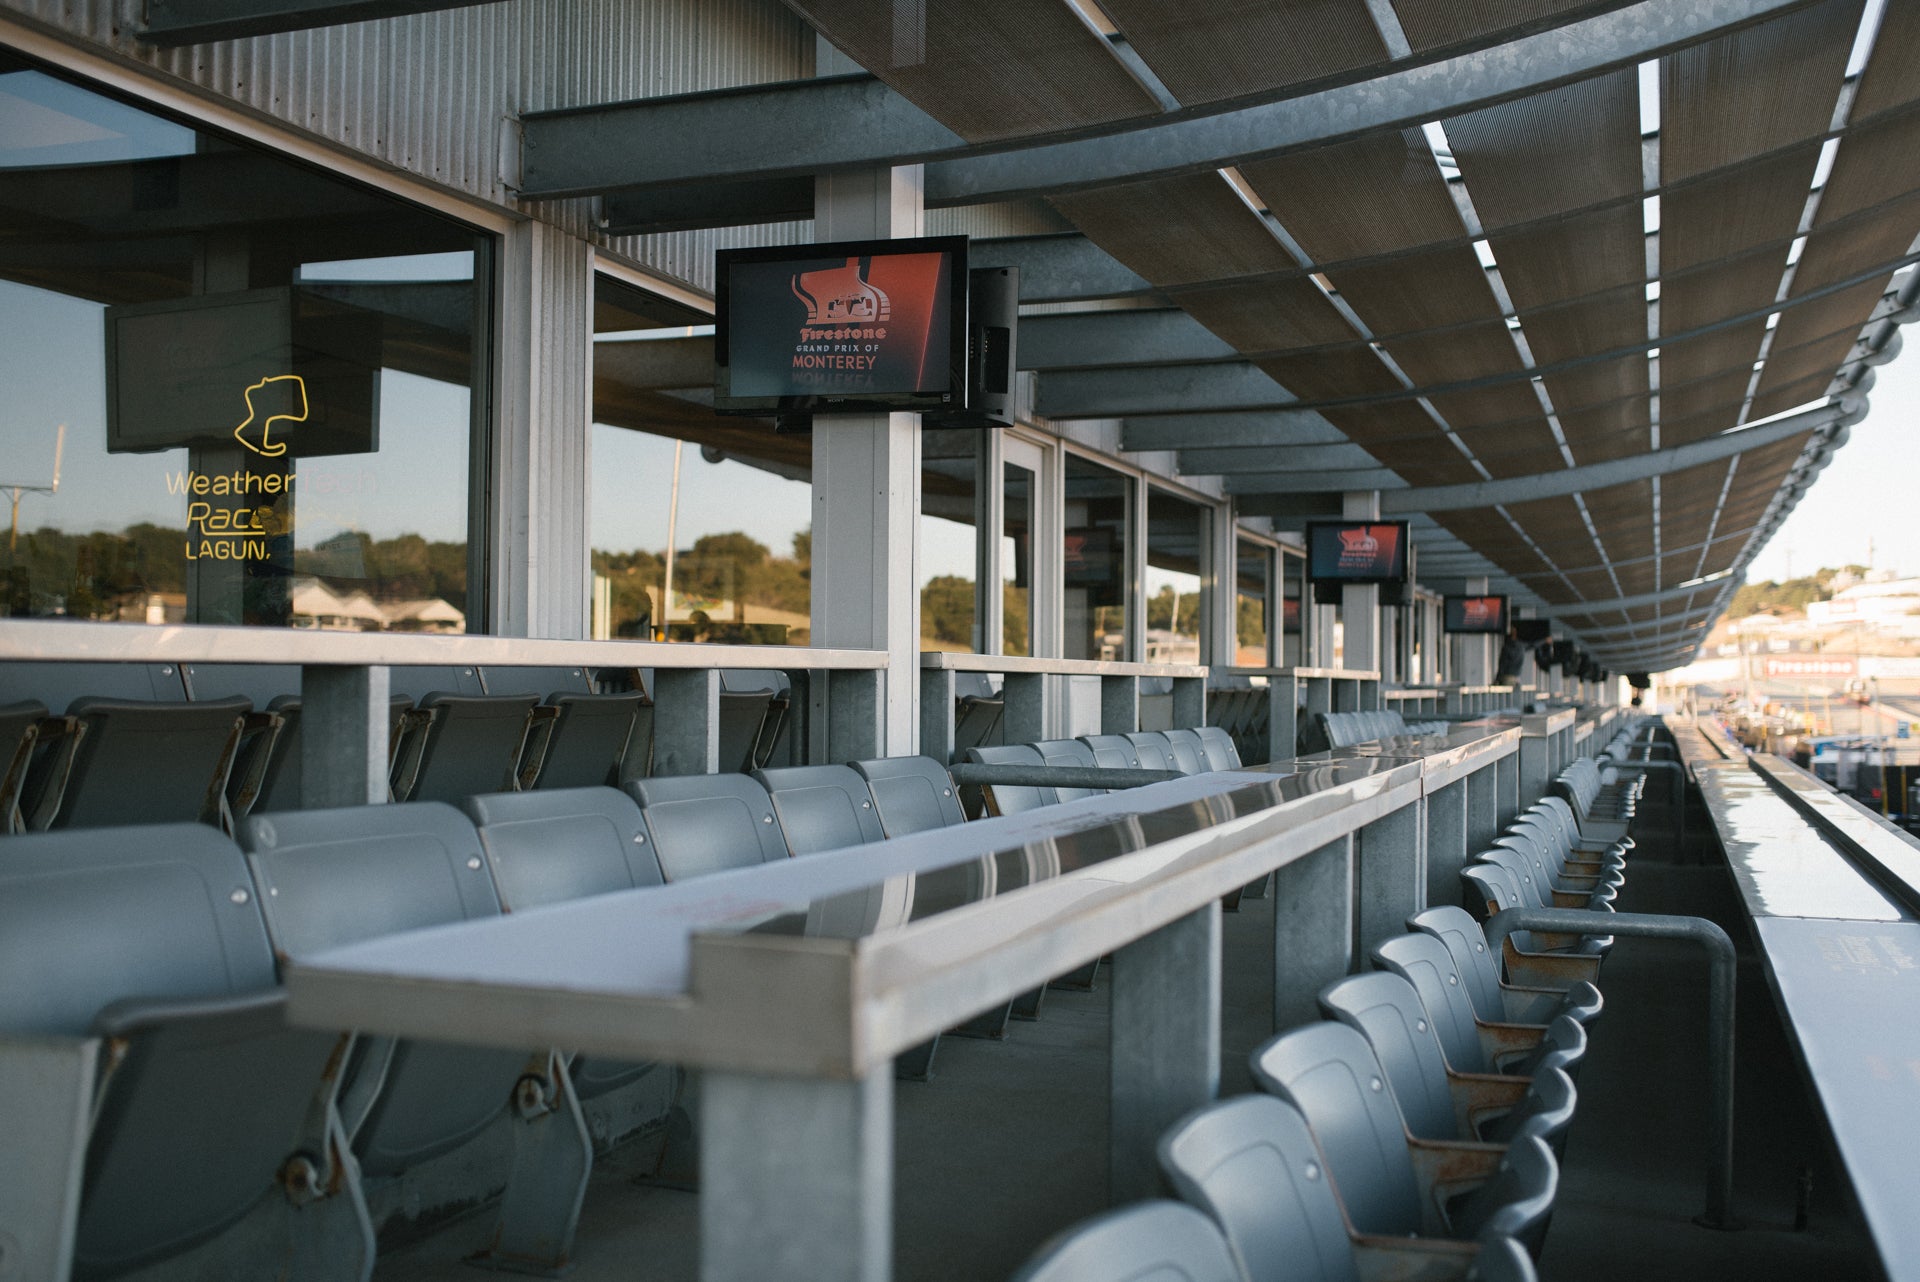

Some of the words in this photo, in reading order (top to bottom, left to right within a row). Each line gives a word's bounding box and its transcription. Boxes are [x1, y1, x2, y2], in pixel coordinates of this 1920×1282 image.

[800, 328, 887, 343] Firestone
[796, 344, 830, 352] GRAND
[834, 344, 860, 352] PRIX
[864, 344, 880, 352] OF
[792, 355, 877, 370] MONTEREY
[185, 540, 271, 560] LAGUN
